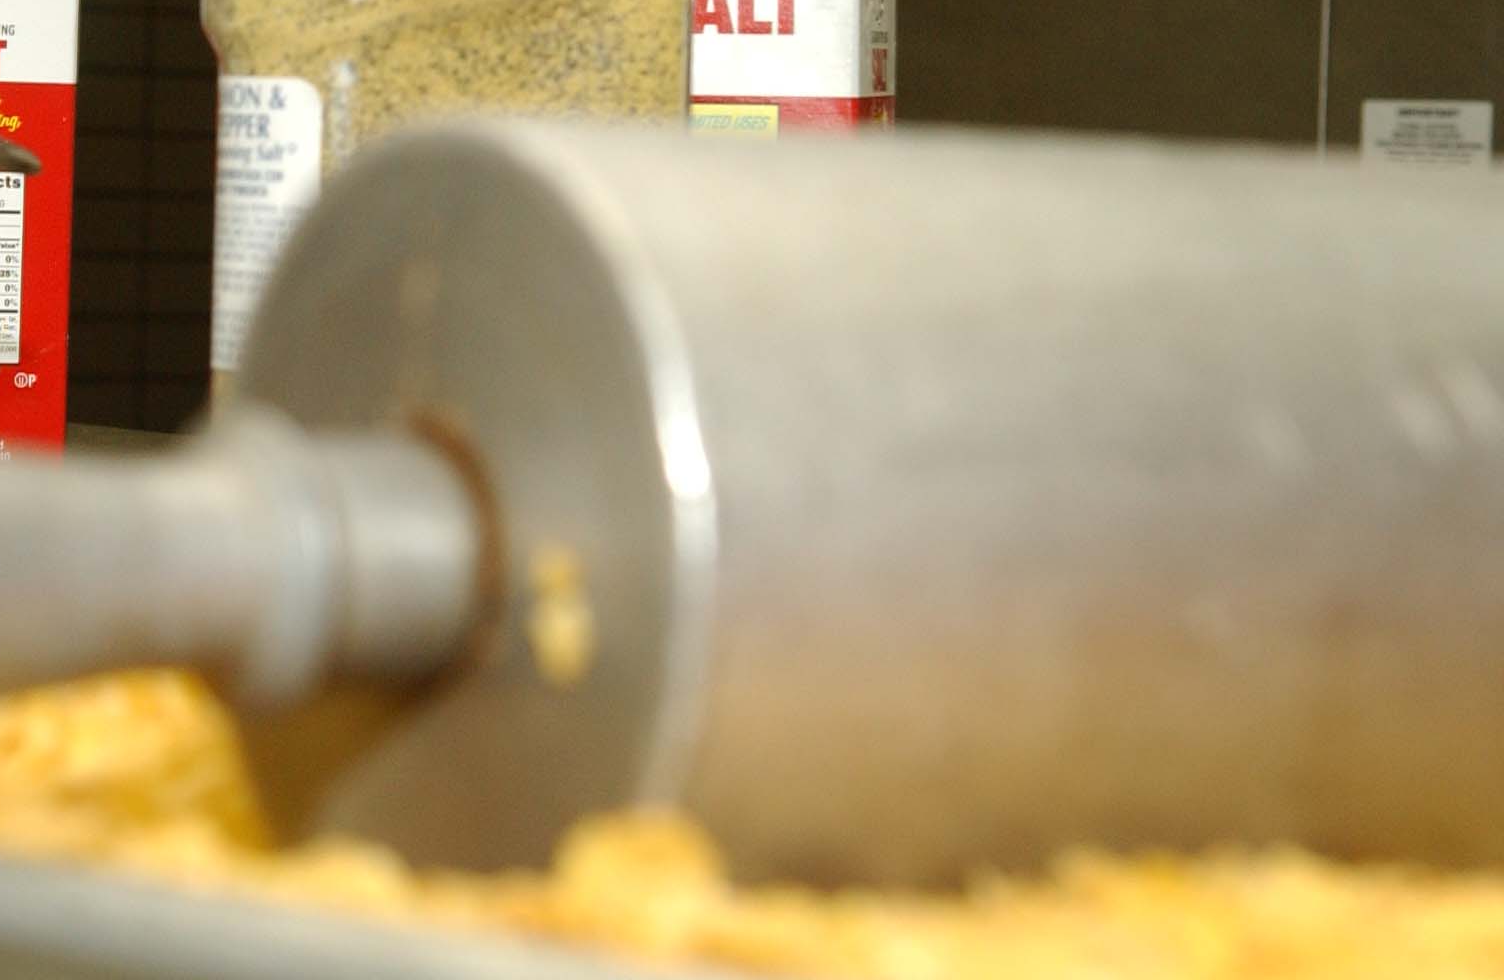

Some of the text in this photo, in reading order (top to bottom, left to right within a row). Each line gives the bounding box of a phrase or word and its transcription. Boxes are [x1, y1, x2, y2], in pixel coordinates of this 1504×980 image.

[5, 255, 19, 264] 0%
[4, 284, 18, 293] 0%
[3, 298, 18, 308] 0%
